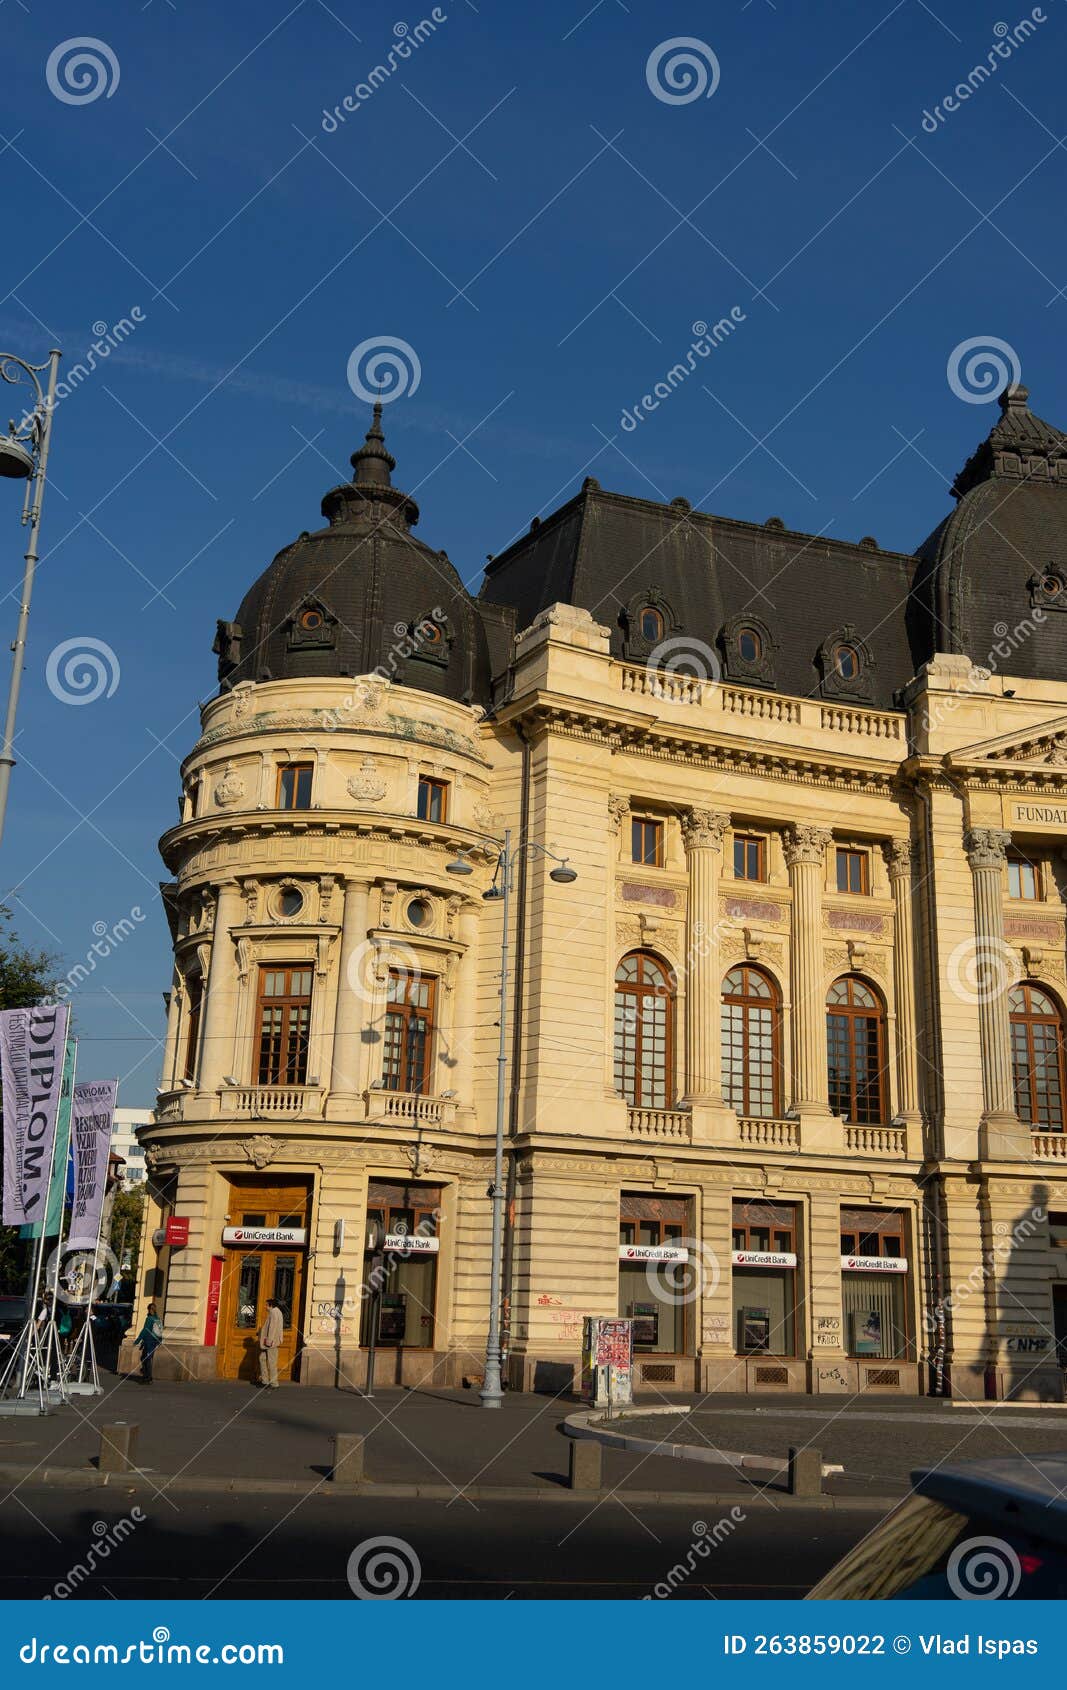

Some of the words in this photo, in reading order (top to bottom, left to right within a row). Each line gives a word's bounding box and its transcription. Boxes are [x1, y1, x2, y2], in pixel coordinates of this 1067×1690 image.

[244, 1231, 275, 1240] UniCredit
[276, 1232, 294, 1240] Bank
[415, 1239, 430, 1248] Bank
[663, 1250, 679, 1258] Bank
[745, 1255, 772, 1263] UniCredit
[773, 1256, 788, 1264] Bank
[856, 1259, 882, 1268] UniCredit
[883, 1260, 898, 1269] Bank
